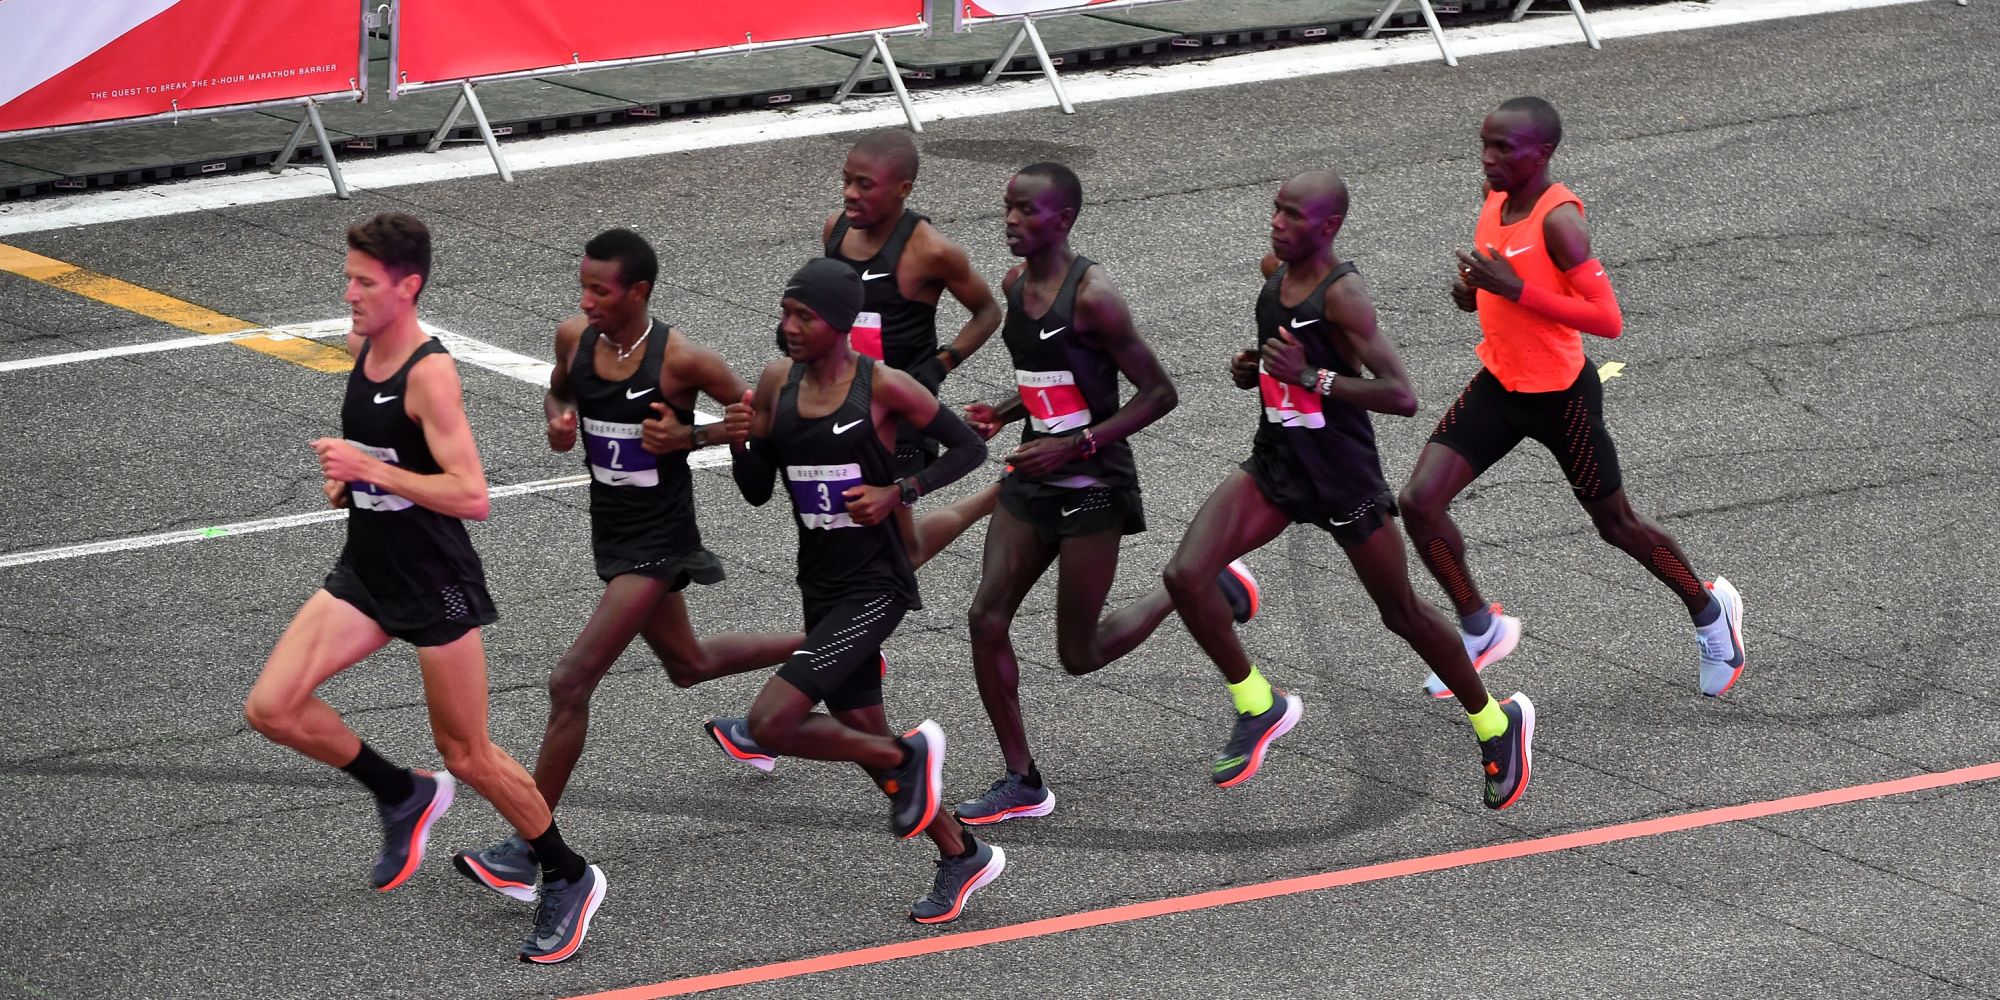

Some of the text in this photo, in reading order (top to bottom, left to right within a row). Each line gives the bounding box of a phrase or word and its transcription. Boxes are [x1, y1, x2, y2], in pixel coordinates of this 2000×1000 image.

[90, 64, 337, 100] THE QUEST TO BREAK THE 2-HOUR MARATHON BARRIER
[1037, 389, 1054, 416] 1
[1279, 381, 1295, 408] 2
[607, 440, 623, 469] 2
[817, 482, 832, 512] 3
